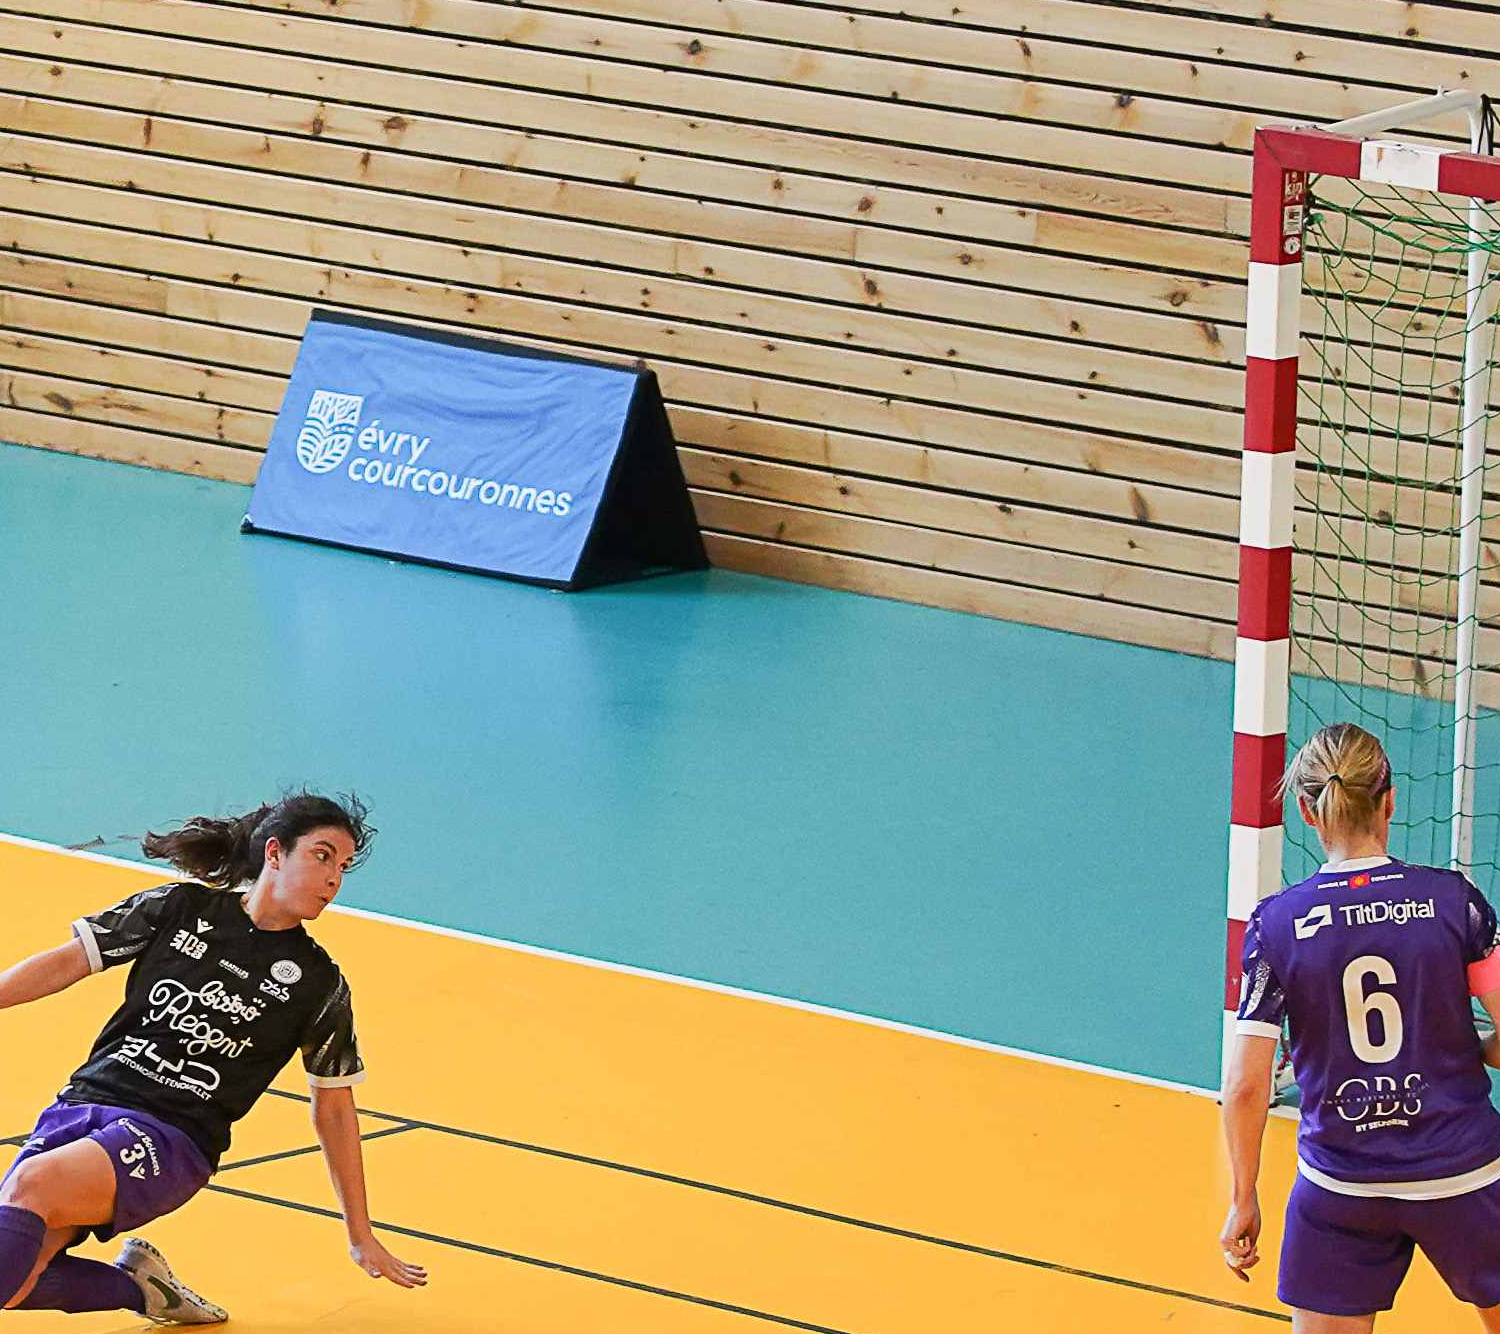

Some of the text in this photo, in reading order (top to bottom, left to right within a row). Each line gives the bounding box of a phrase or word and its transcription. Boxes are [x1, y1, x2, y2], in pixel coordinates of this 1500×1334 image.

[357, 419, 432, 465] évry
[347, 457, 573, 517] courcouronnes
[1338, 898, 1436, 926] TiltDigital
[1342, 954, 1404, 1064] 6
[119, 1142, 146, 1165] 3
